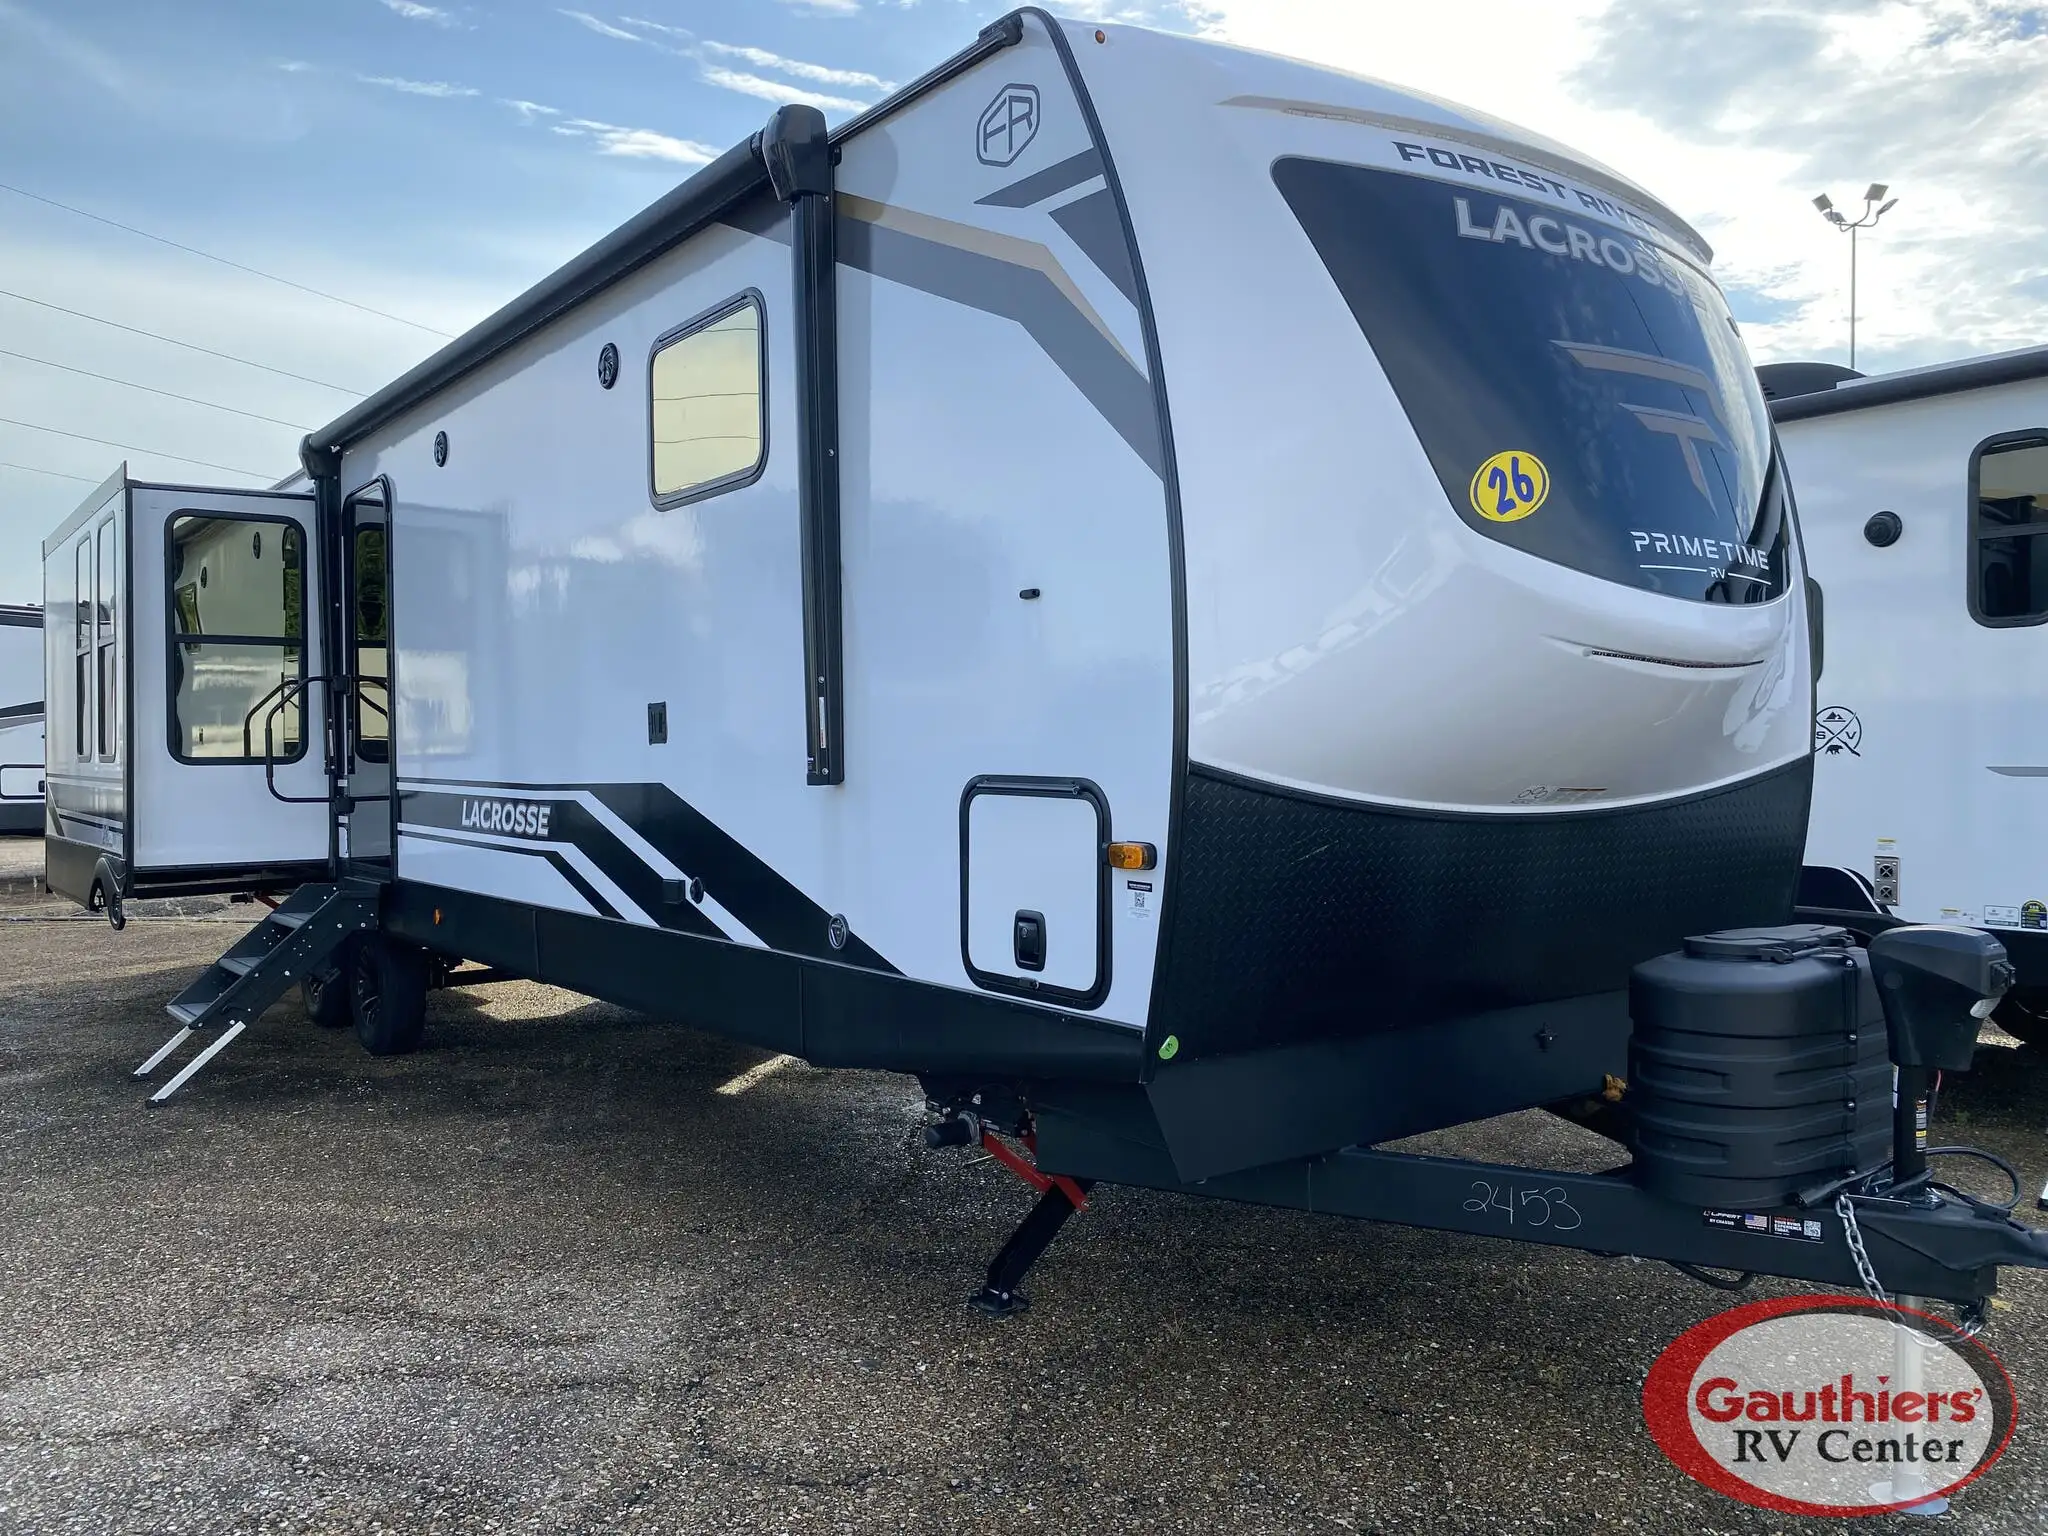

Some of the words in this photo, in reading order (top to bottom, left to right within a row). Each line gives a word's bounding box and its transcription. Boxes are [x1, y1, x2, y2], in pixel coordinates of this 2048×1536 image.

[1391, 141, 1566, 199] FOREST
[1453, 195, 1708, 312] LACROSSE
[1487, 456, 1535, 516] 26
[1708, 566, 1727, 580] RV
[461, 799, 551, 837] LACROSSE
[1462, 1180, 1582, 1231] 2453
